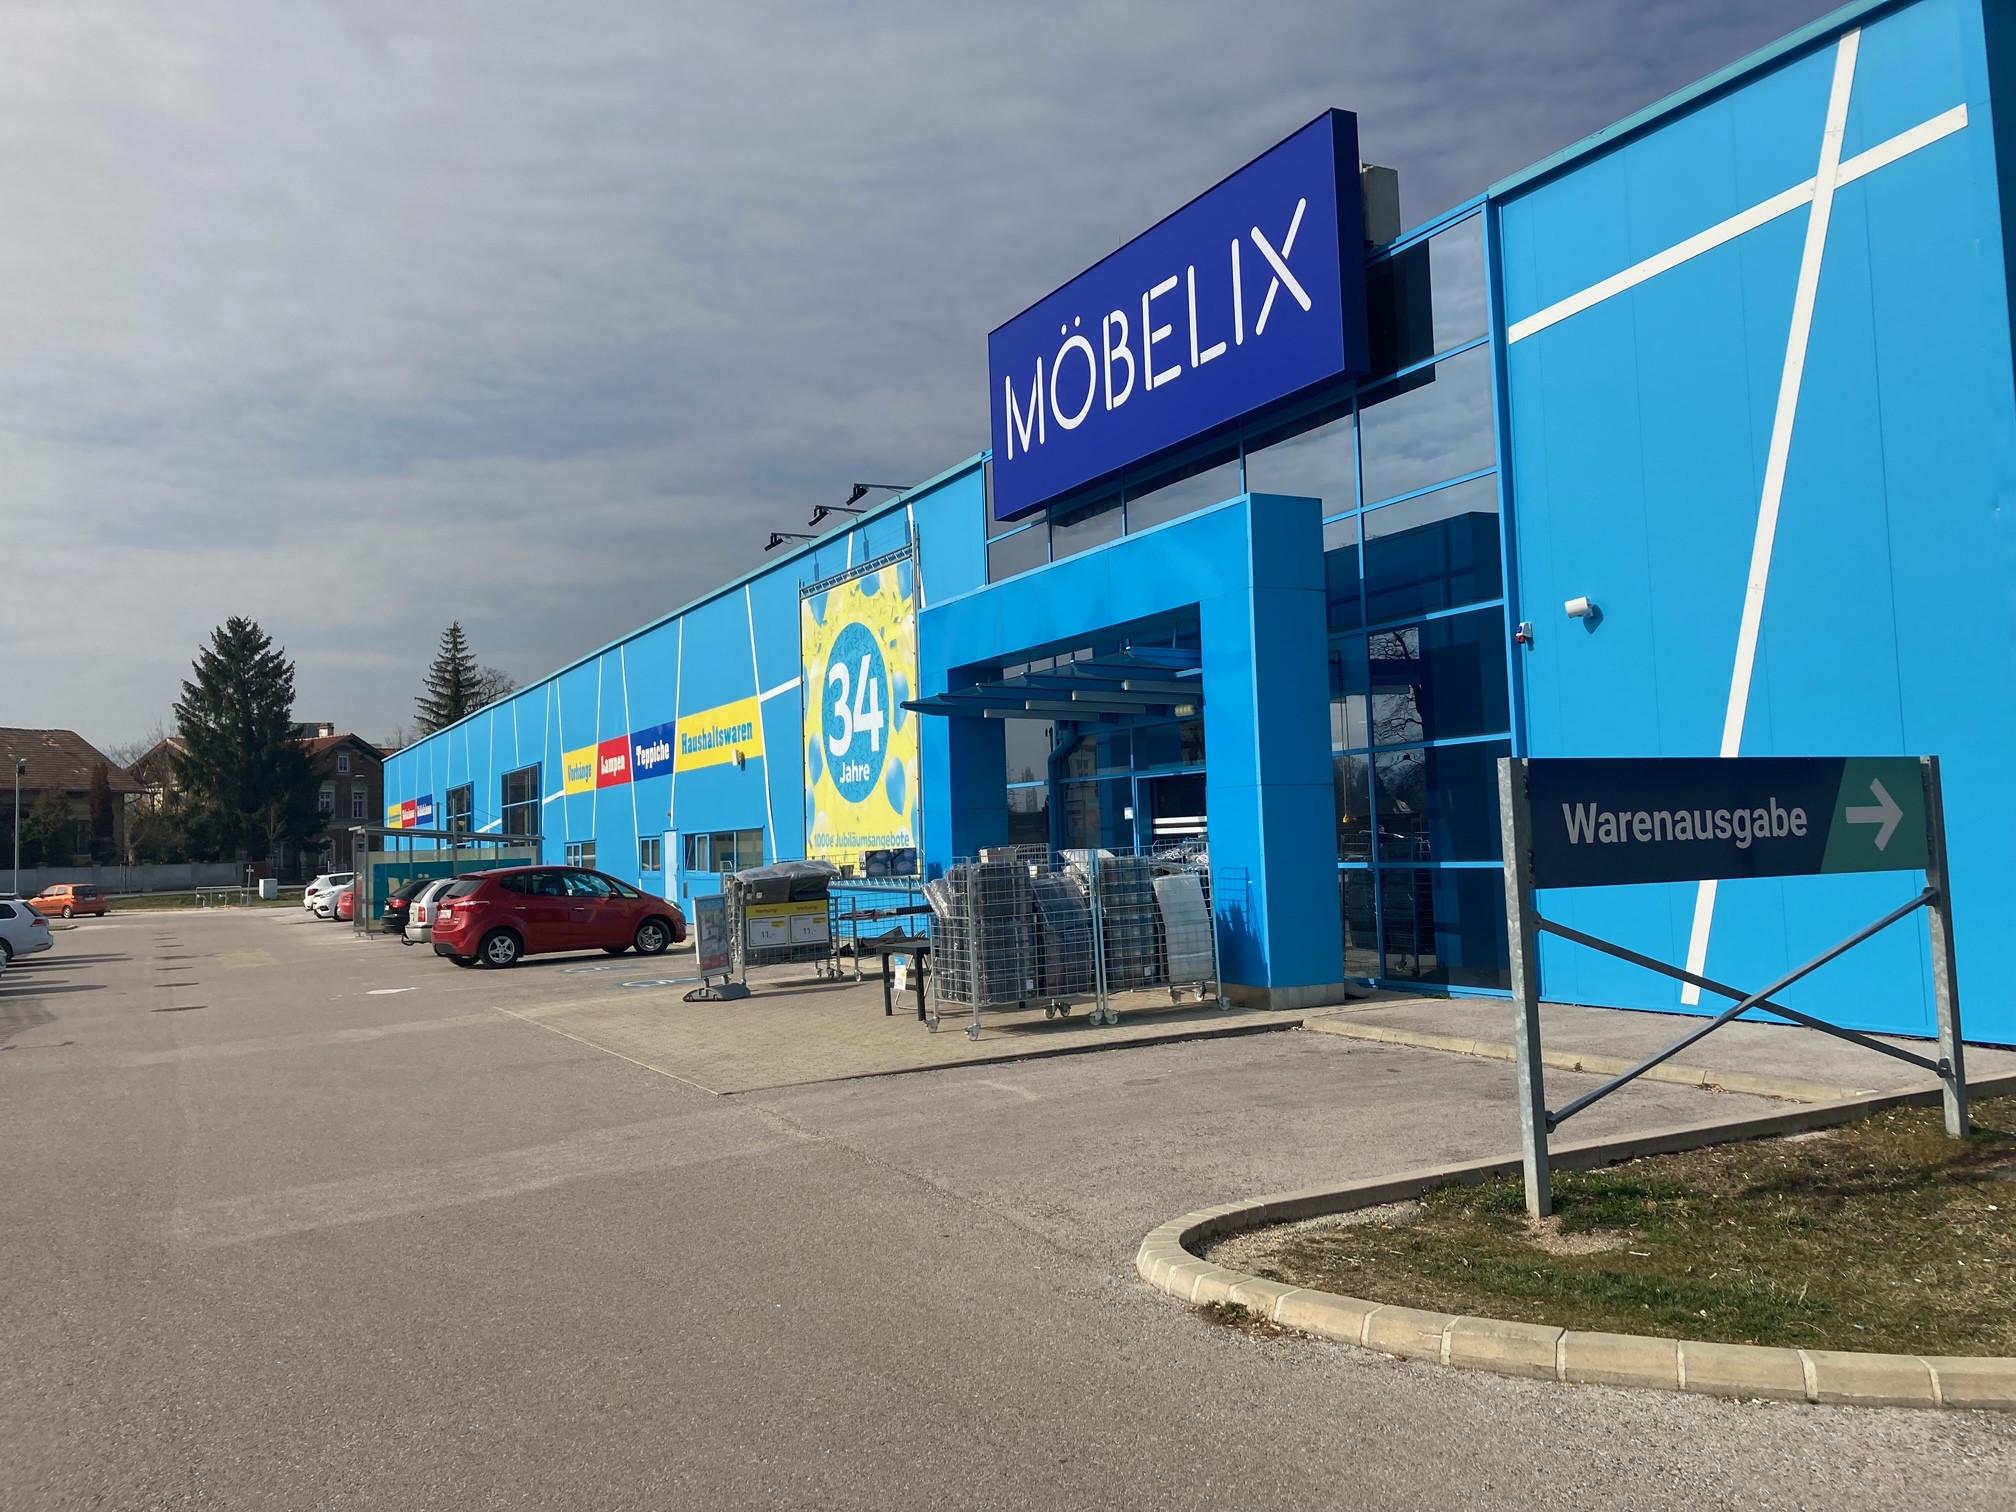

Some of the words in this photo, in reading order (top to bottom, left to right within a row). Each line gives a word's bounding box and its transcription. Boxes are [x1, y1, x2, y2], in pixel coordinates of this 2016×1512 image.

[1005, 198, 1311, 460] MÖBELIX
[829, 654, 883, 756] 34
[681, 722, 752, 754] Haushaltswaren
[601, 755, 625, 776] Lampen
[636, 740, 669, 769] Teppiche
[840, 760, 870, 783] Jahre
[1562, 797, 1807, 849] Warenausgabe
[835, 832, 909, 848] Jubiläumsangebote
